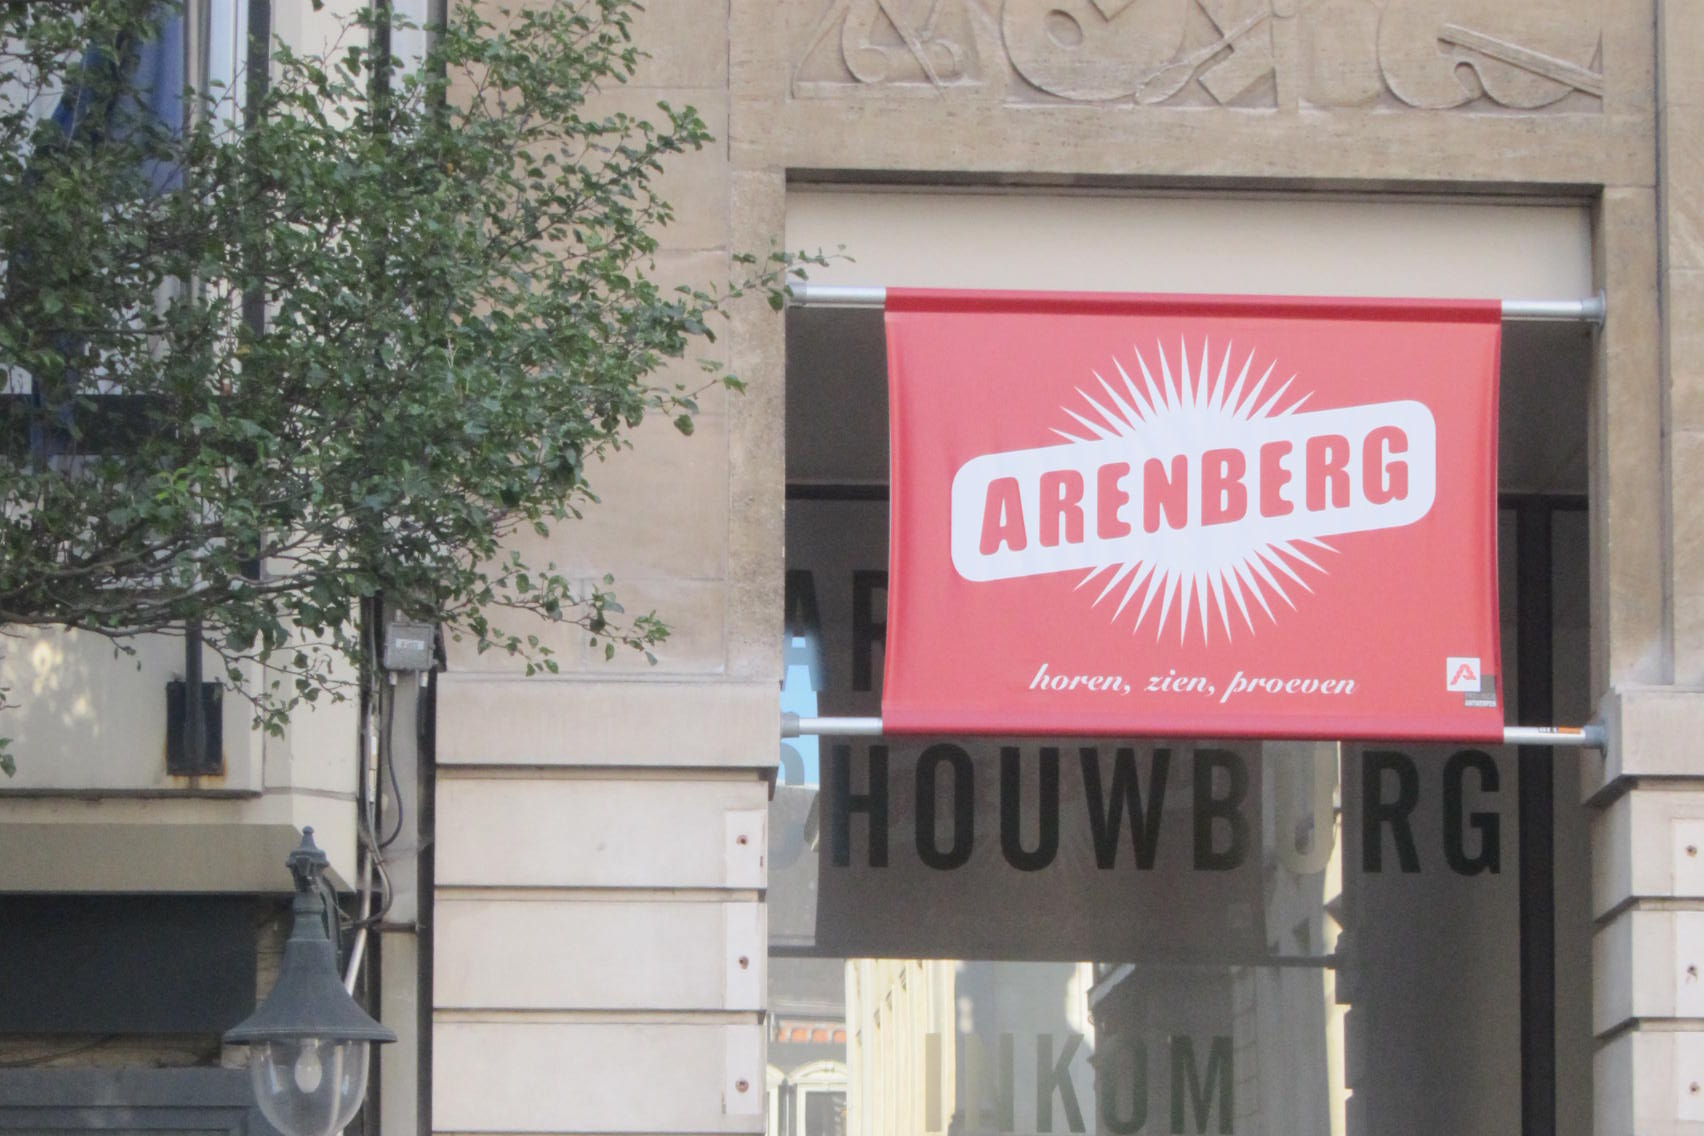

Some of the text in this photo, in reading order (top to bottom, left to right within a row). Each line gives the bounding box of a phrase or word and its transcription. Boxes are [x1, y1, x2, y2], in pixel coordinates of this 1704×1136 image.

[979, 425, 1408, 556] ARENBERG
[1030, 664, 1356, 703] horen, zien, proeven
